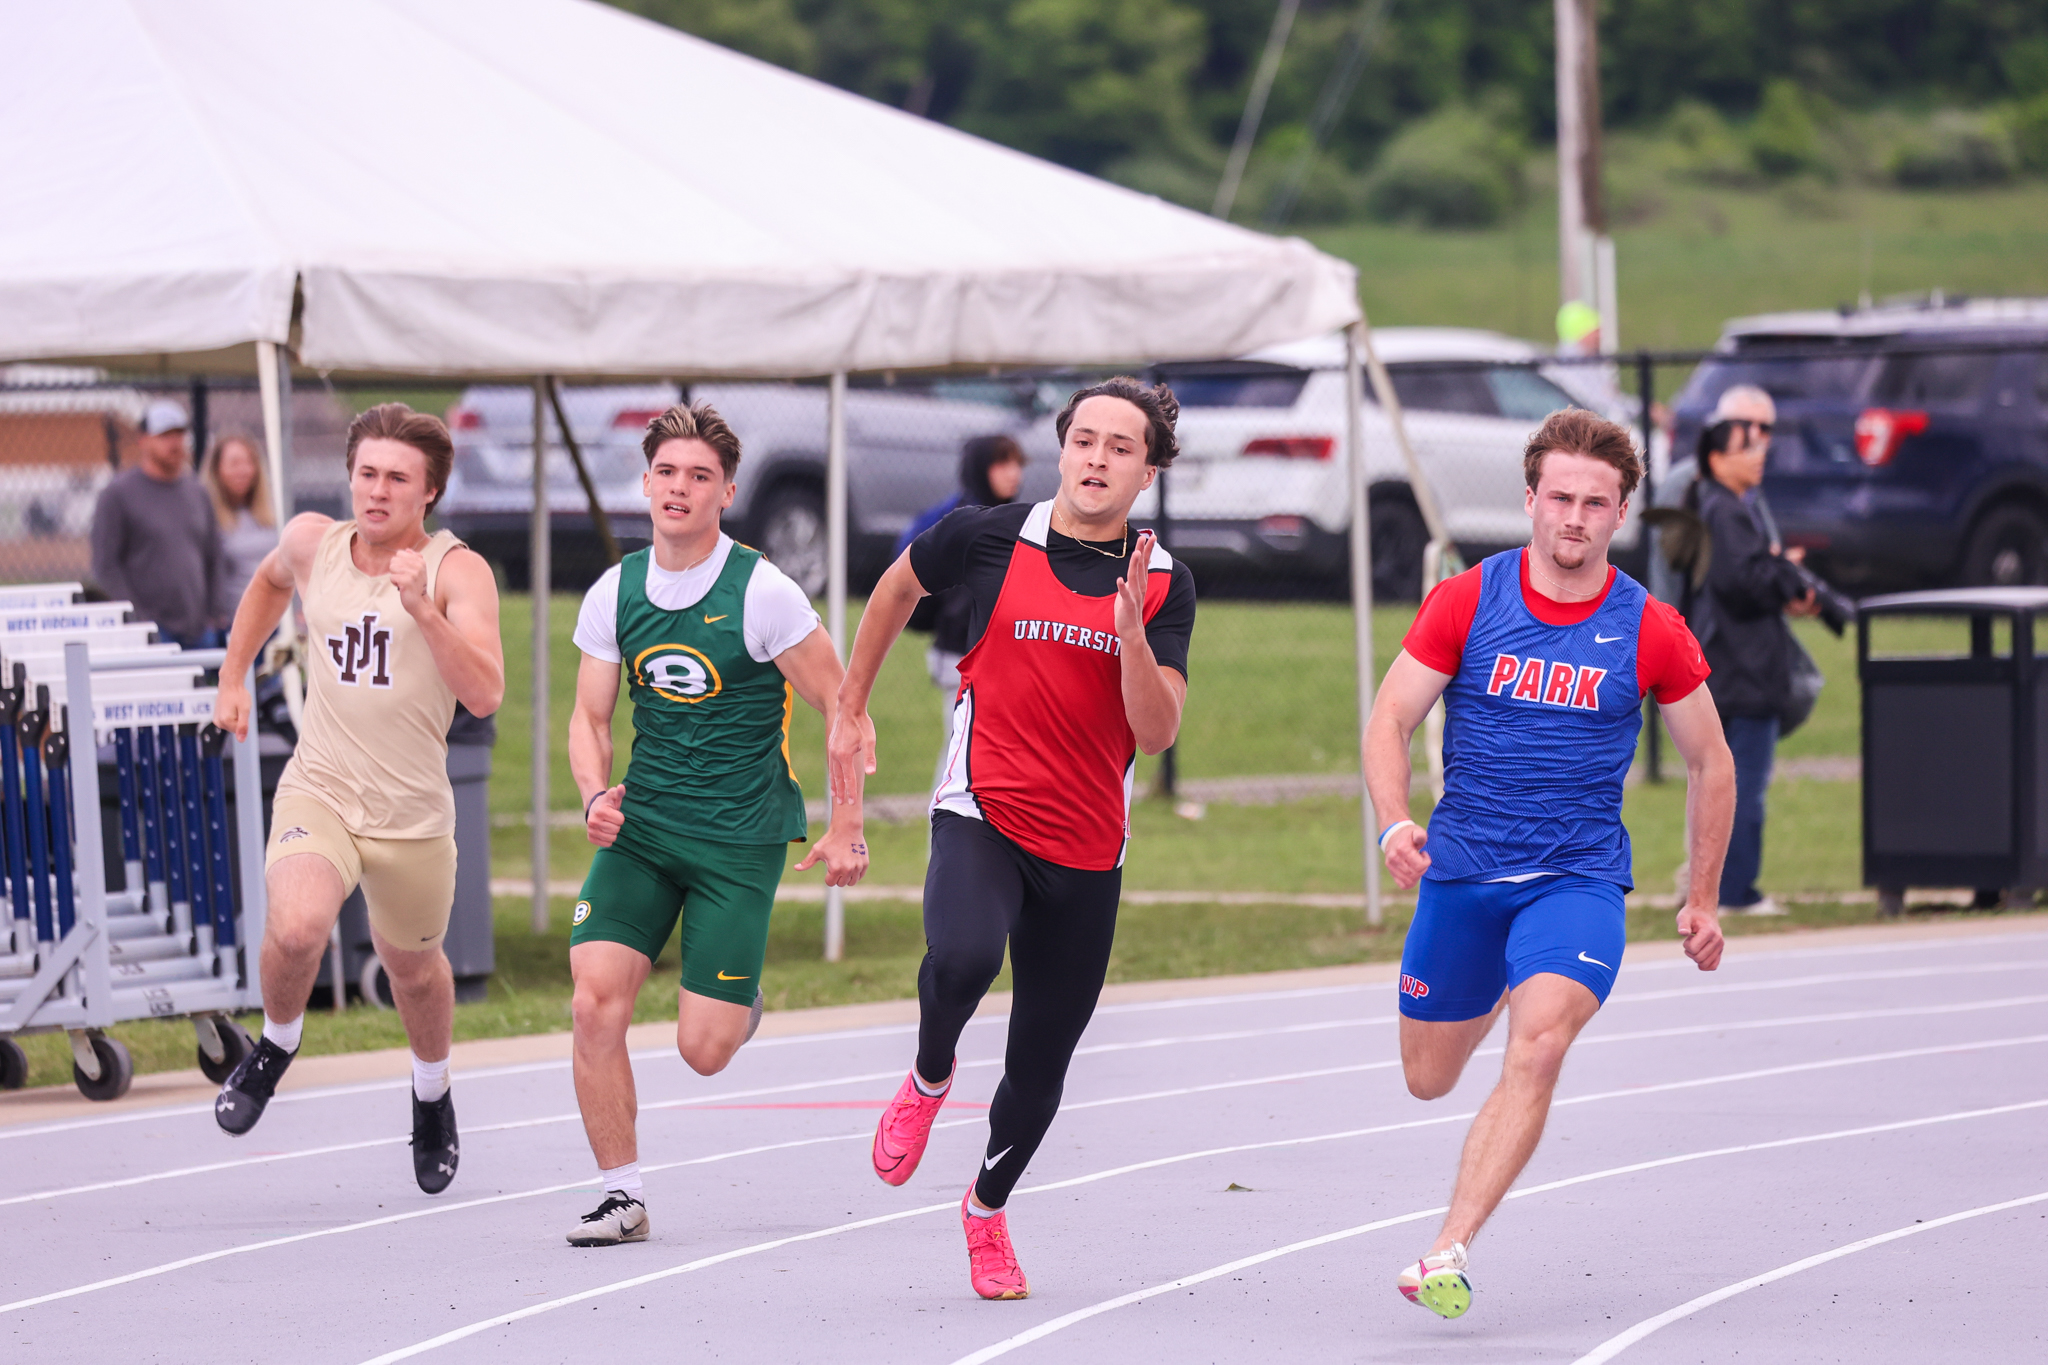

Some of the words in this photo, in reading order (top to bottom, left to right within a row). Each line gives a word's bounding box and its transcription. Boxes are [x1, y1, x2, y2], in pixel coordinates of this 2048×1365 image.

[7, 617, 37, 632] WEST
[41, 614, 89, 630] VIRGINIA
[1014, 620, 1121, 657] UNIVERSIT
[645, 654, 707, 695] B
[1486, 653, 1608, 712] PARK
[104, 704, 134, 720] WEST
[138, 702, 185, 717] VIRGINIA
[573, 903, 589, 922] B
[1401, 973, 1429, 1000] WP
